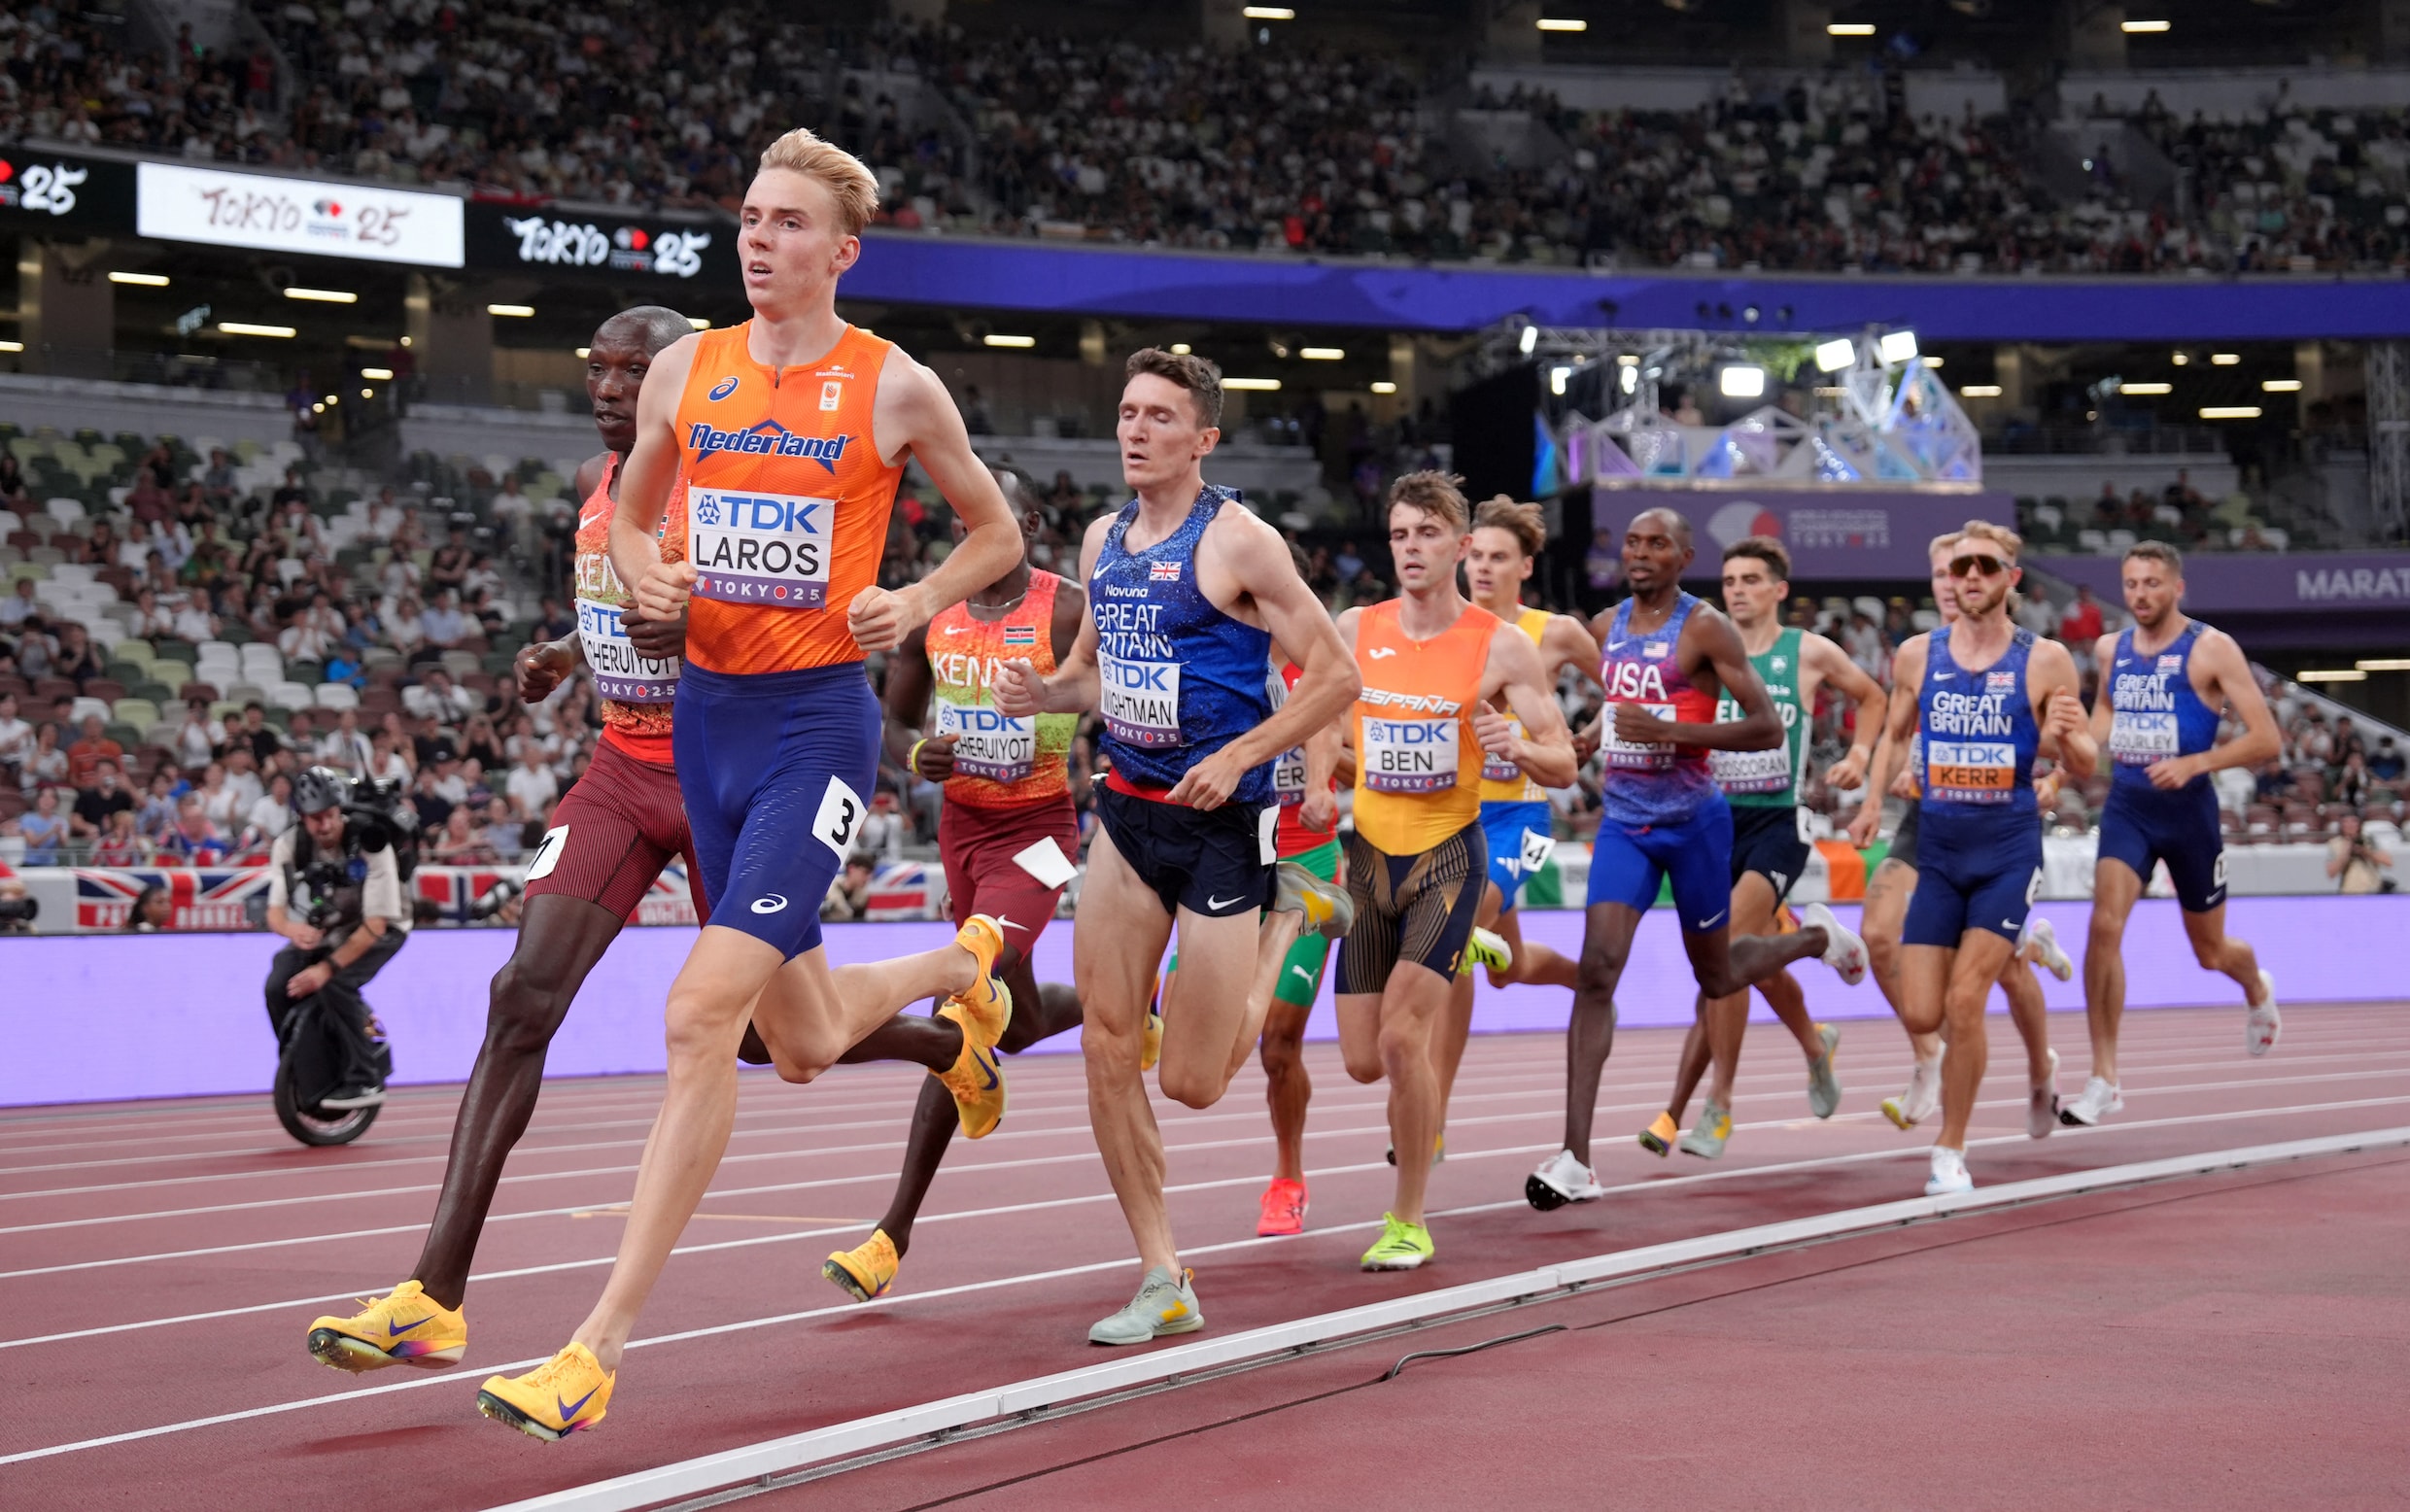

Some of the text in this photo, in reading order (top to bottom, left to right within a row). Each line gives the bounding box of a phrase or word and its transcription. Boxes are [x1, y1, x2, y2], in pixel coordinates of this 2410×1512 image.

[20, 162, 87, 215] 25
[195, 187, 409, 245] TOKYO 25
[503, 217, 609, 266] TOKYO
[653, 229, 711, 278] 25
[688, 422, 848, 462] Nederland
[720, 497, 821, 534] TDK
[696, 534, 819, 575] LAROS
[793, 588, 820, 601] 25
[1105, 584, 1149, 598] Novuna
[1093, 603, 1163, 632] GREAT
[1111, 660, 1169, 692] TDK
[1601, 661, 1669, 701] USA
[2116, 673, 2170, 692] GREAT
[1103, 687, 1173, 725] WIGHTMAN
[1360, 686, 1462, 716] ESPAÑA
[1933, 691, 2007, 715] GREAT
[2113, 691, 2175, 712] BRITAIN
[953, 709, 1025, 732] TDK
[1384, 722, 1449, 743] TDK
[1929, 711, 2013, 737] BRITAIN
[2125, 714, 2171, 730] TDK
[1382, 750, 1433, 772] BEN
[1950, 746, 2007, 763] TDK
[1941, 768, 1999, 786] KERR
[831, 798, 855, 846] 3
